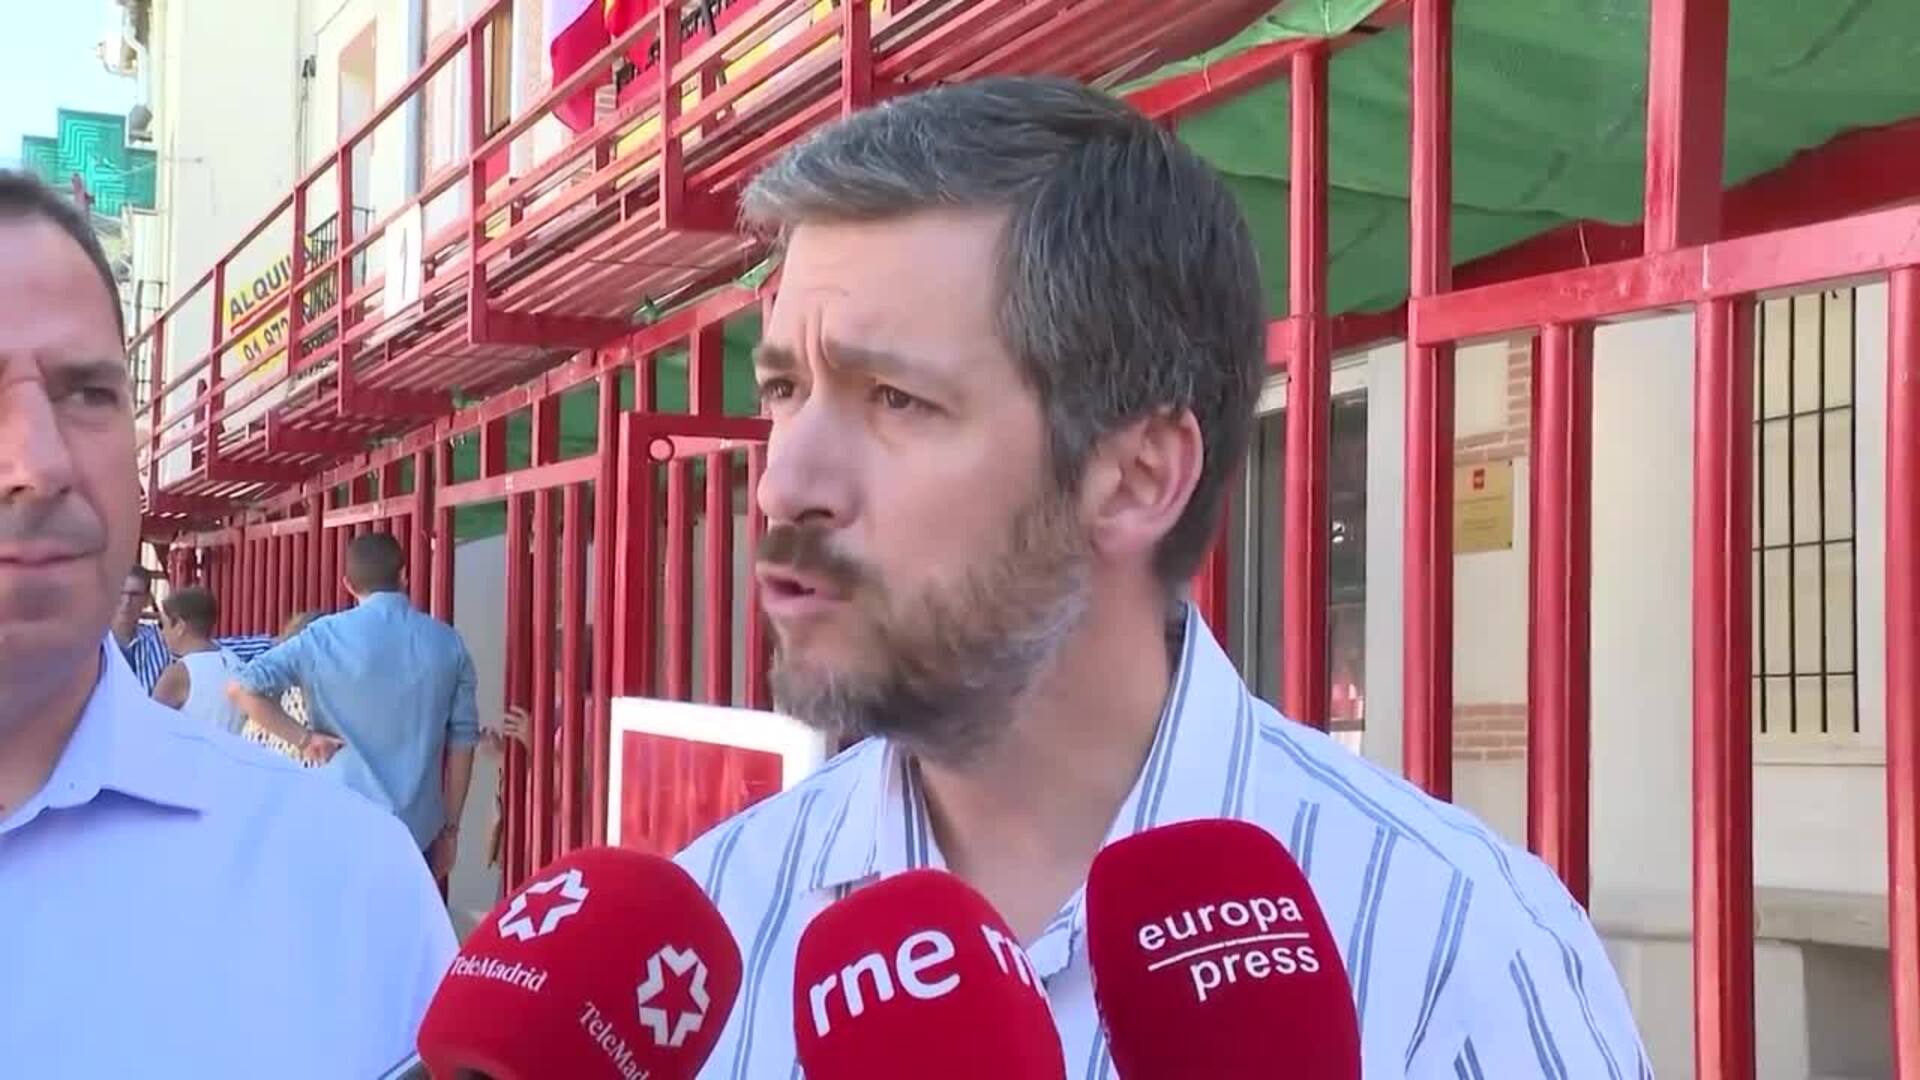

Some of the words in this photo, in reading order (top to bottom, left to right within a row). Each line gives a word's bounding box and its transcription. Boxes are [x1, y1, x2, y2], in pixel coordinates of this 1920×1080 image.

[1138, 897, 1303, 950] europa
[450, 954, 548, 992] TeleMadrid
[809, 930, 961, 1037] rne
[1190, 946, 1319, 1002] press
